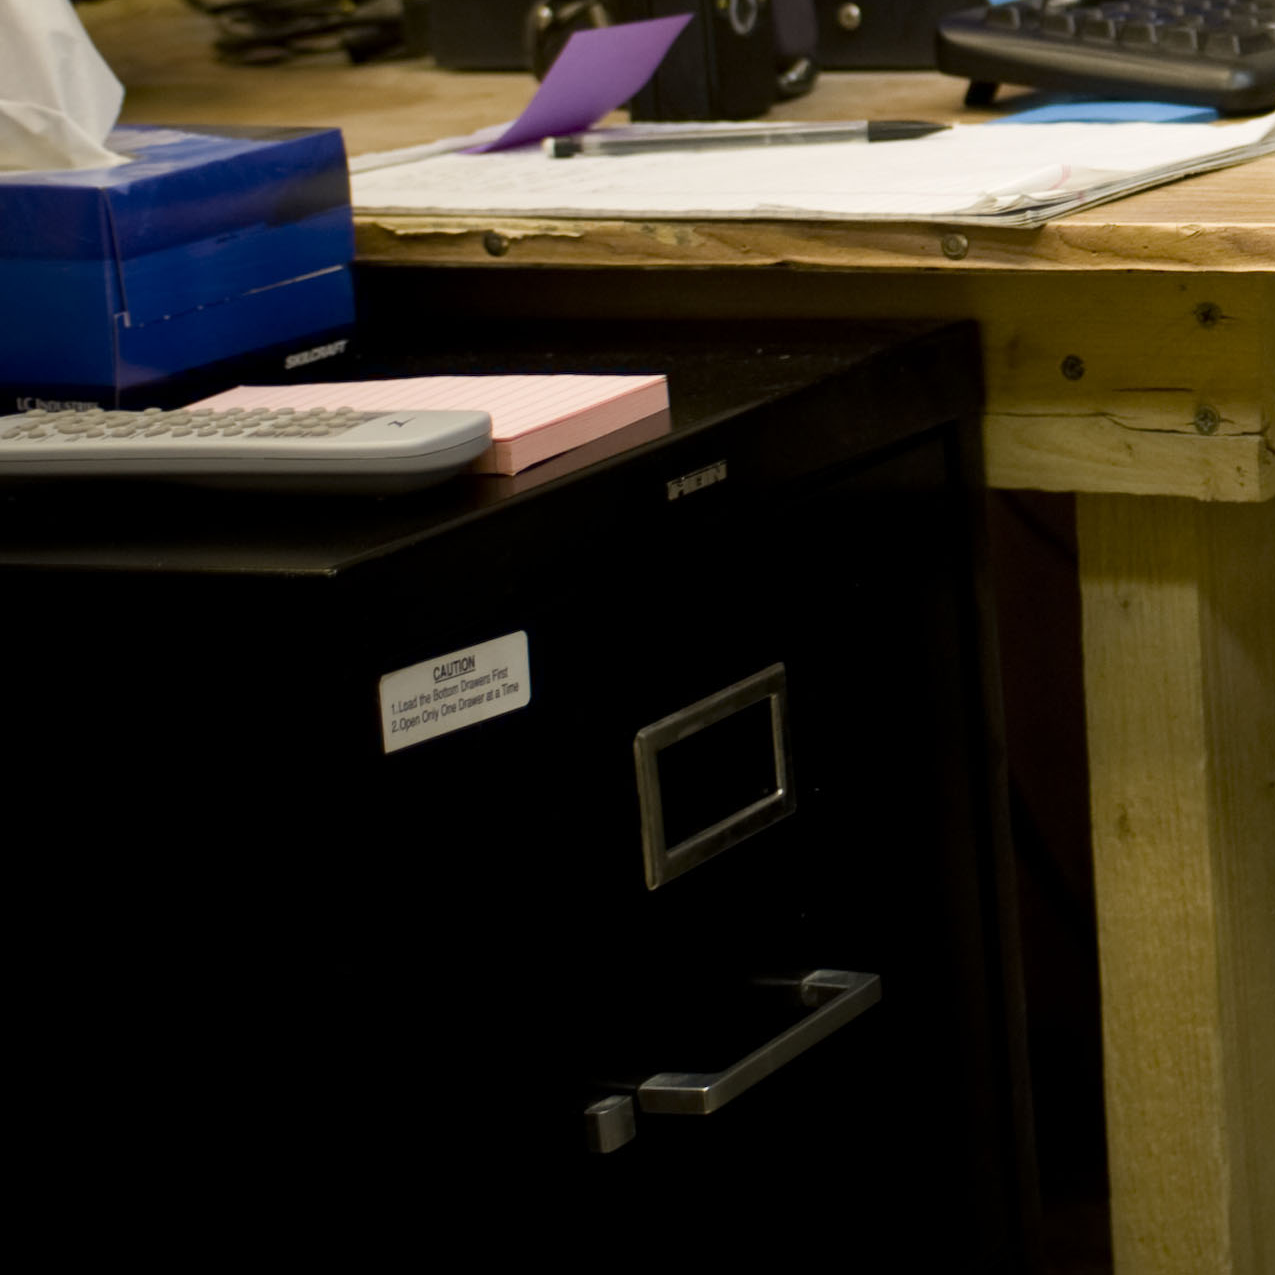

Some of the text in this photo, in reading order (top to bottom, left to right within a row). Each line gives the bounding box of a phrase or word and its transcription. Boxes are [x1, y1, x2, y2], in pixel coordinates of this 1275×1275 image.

[419, 693, 431, 706] the
[433, 685, 458, 701] Bottom
[460, 674, 490, 692] Drawers
[492, 667, 508, 681] First
[433, 655, 475, 681] CAUTION
[422, 709, 439, 722] Only
[441, 702, 456, 716] One
[459, 694, 484, 710] Drawer
[486, 690, 494, 701] at
[502, 682, 519, 696] Time
